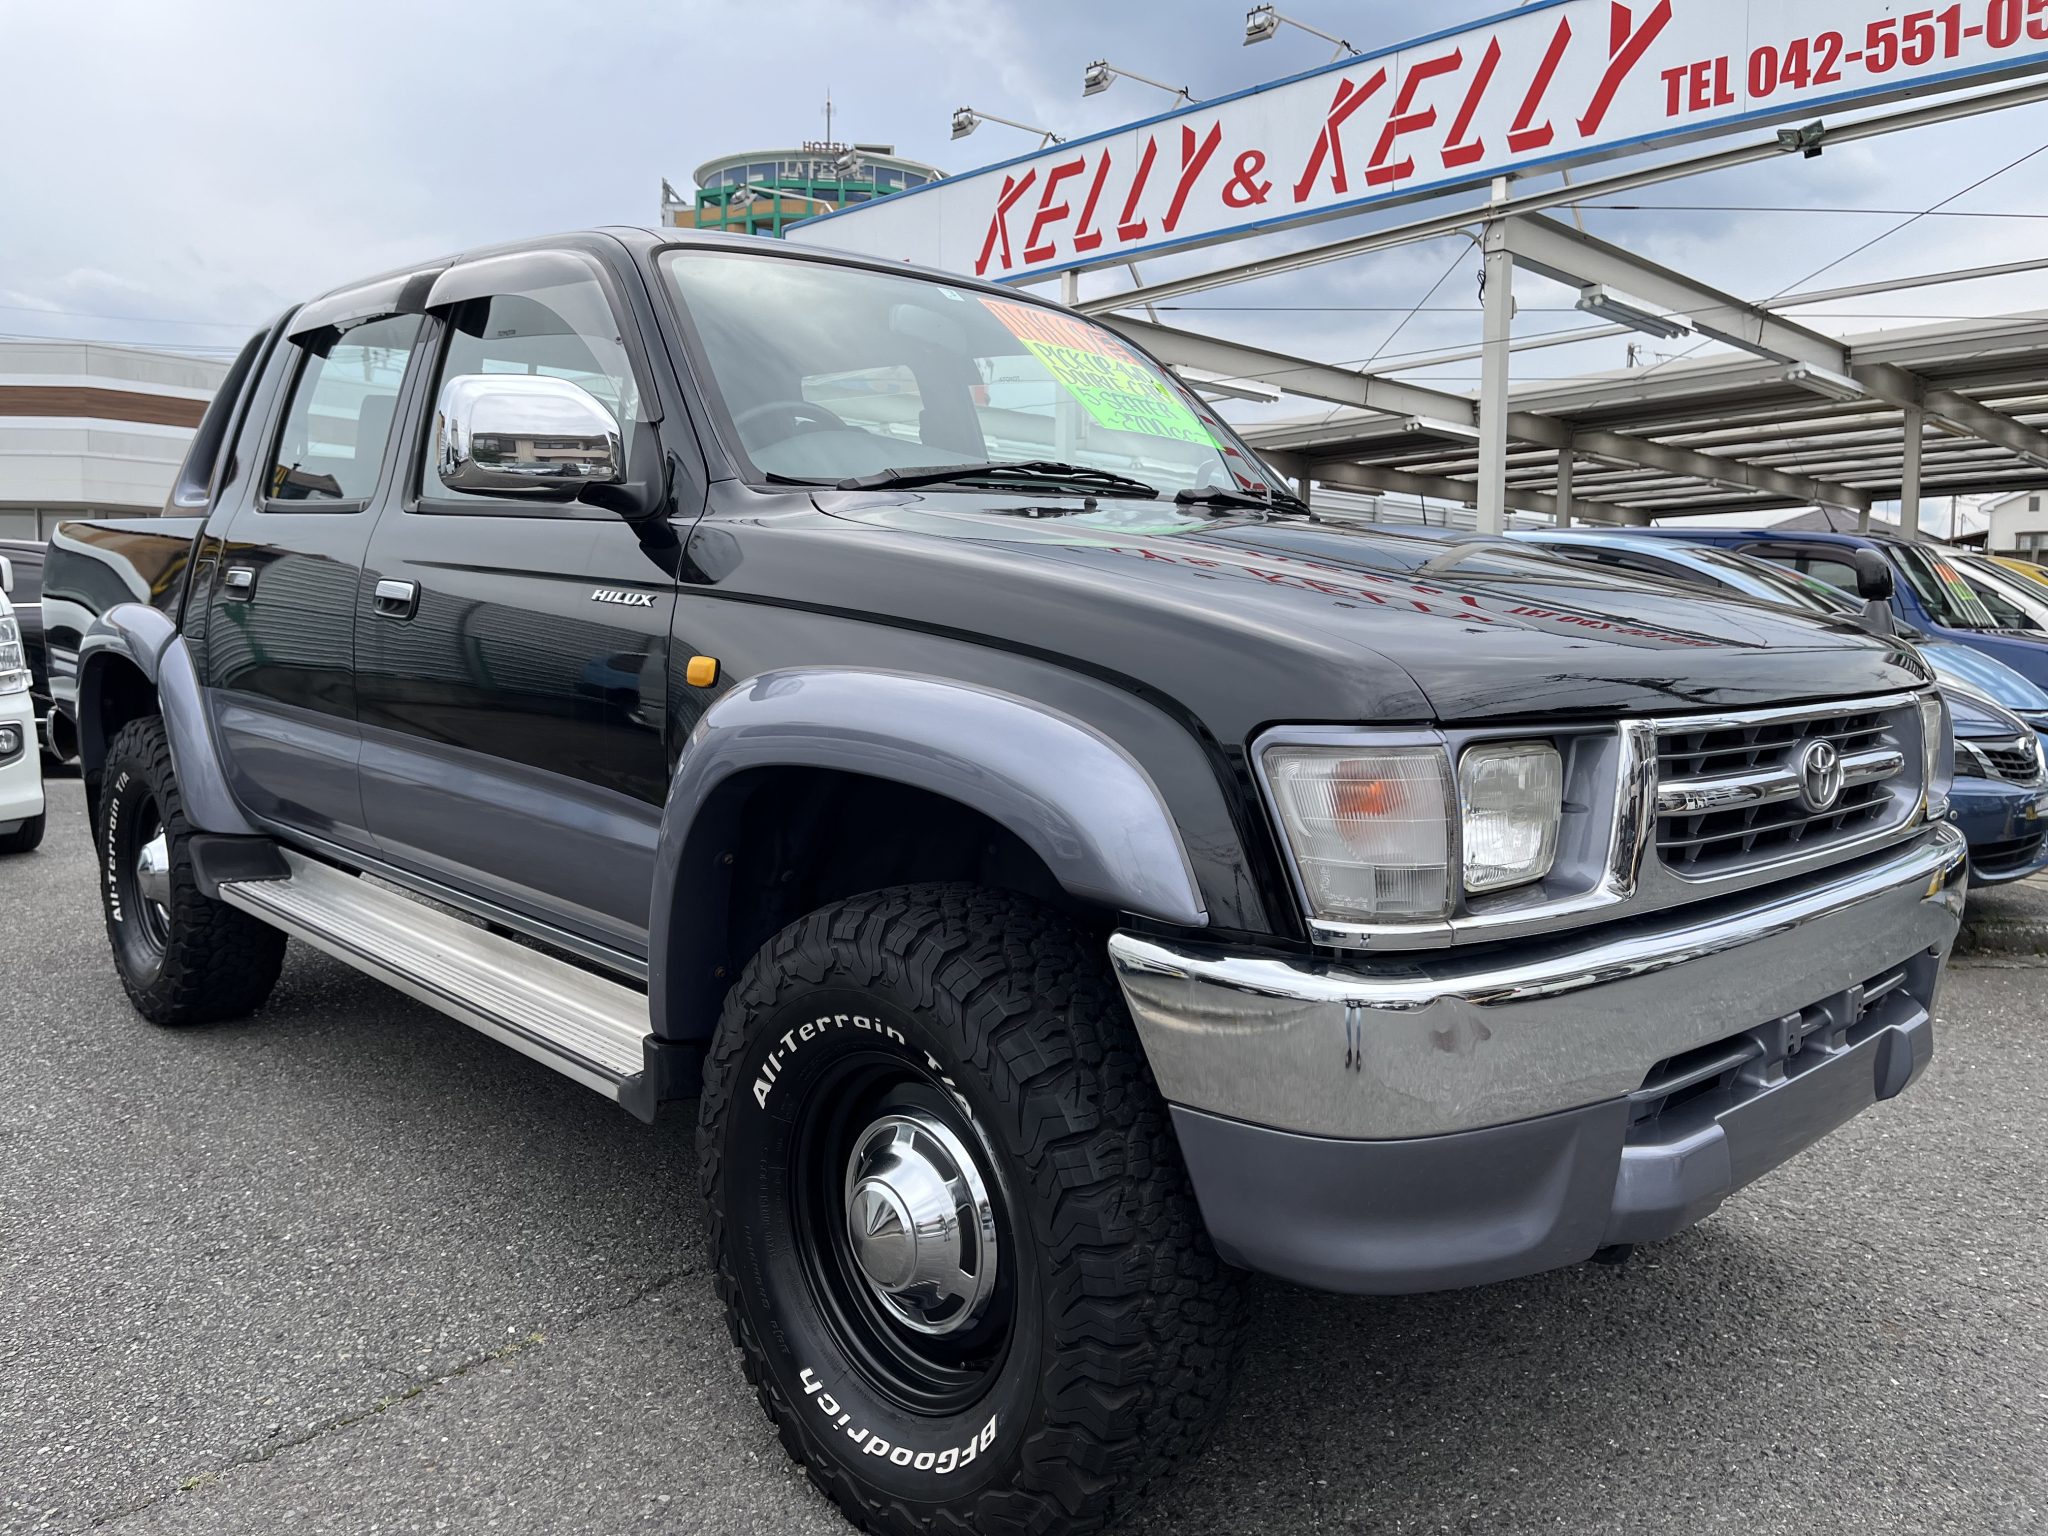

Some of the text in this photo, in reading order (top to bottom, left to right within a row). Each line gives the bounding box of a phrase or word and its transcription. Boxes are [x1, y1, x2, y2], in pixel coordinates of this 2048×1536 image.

[974, 119, 1222, 276] KELLY
[1221, 149, 1273, 208] &
[1292, 0, 1673, 204] KELLY
[1661, 55, 1735, 118] TEL
[591, 589, 657, 608] HILUX
[115, 771, 131, 793] T/A
[752, 1013, 906, 1110] All-Terrain
[799, 1367, 998, 1474] BFGoodrich
